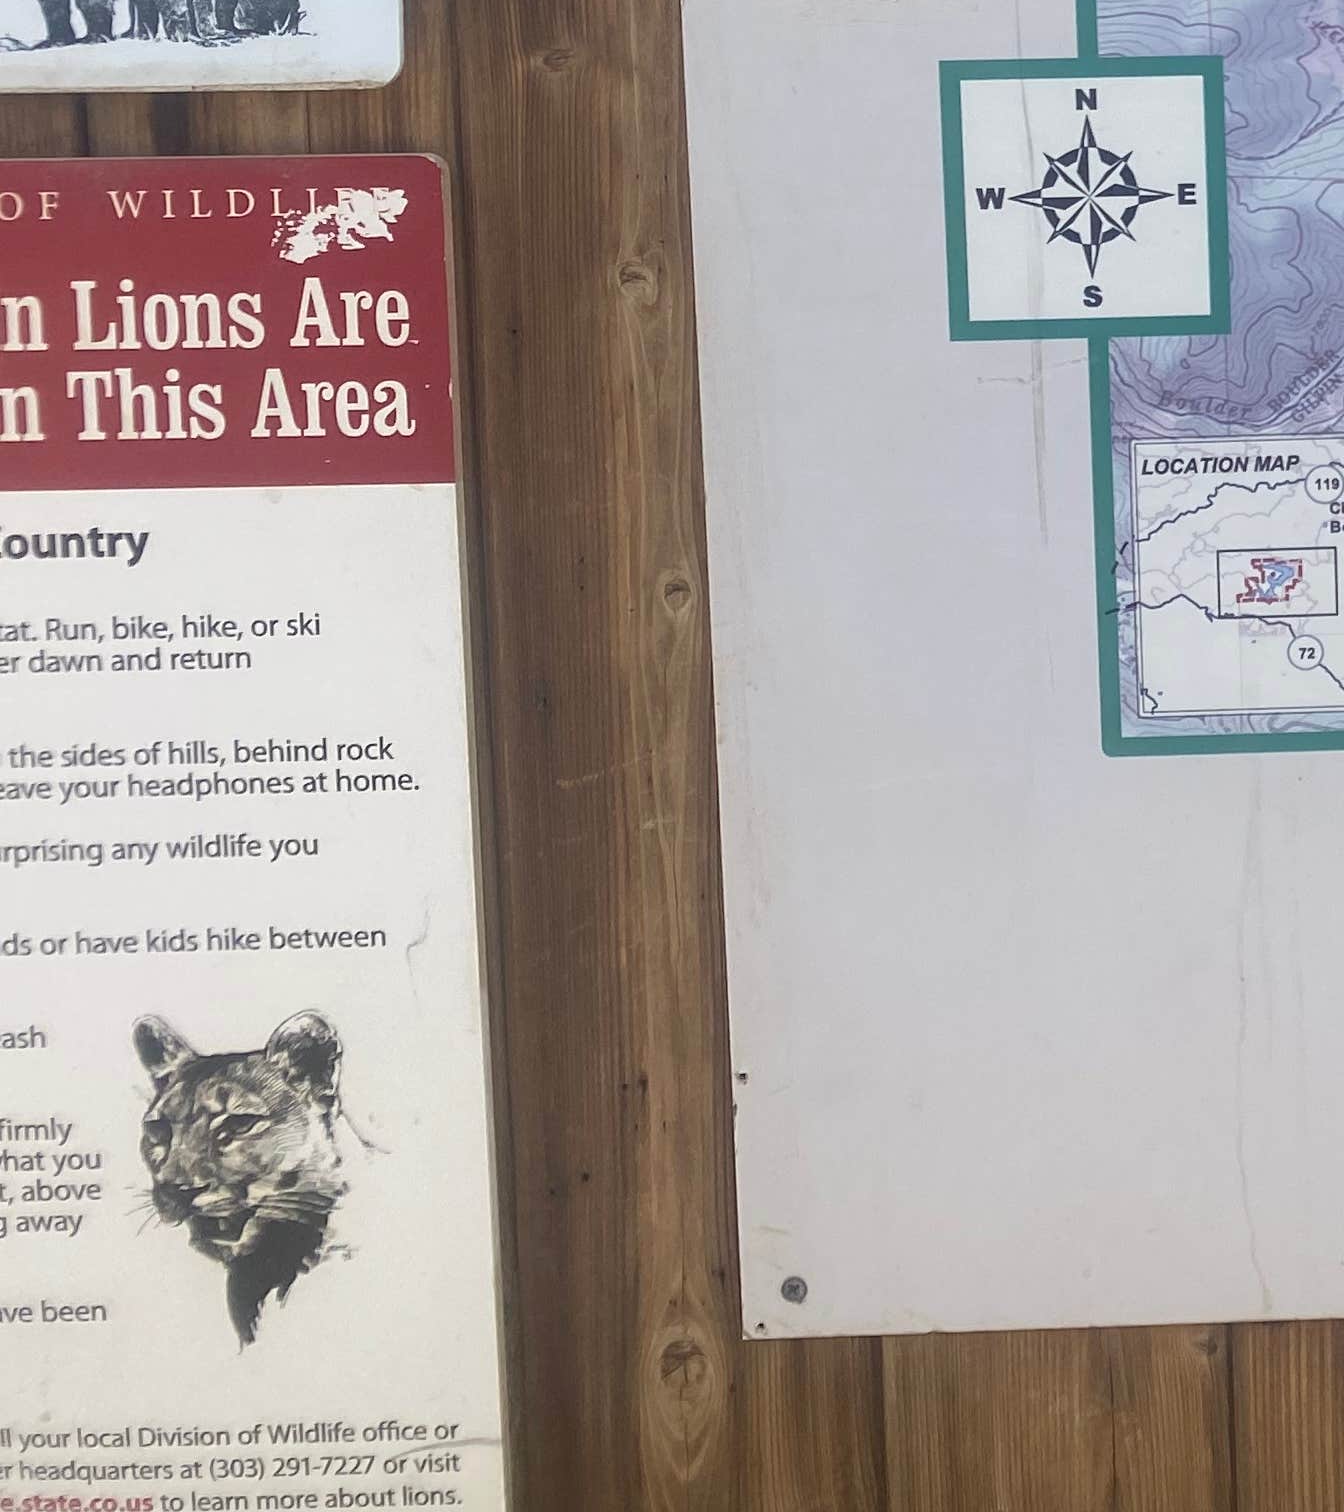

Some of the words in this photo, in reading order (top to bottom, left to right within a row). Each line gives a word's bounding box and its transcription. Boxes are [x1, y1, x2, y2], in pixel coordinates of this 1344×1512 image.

[0, 193, 60, 221] OF
[71, 279, 264, 350] Lions
[290, 278, 409, 346] Are
[67, 368, 225, 440] This
[251, 368, 415, 437] Area
[1142, 456, 1249, 475] LOCATION
[1254, 455, 1300, 472] MAP
[1315, 478, 1339, 490] 119
[1299, 647, 1315, 659] 72
[40, 938, 68, 955] or
[76, 931, 138, 954] have
[146, 929, 198, 952] kids
[207, 928, 261, 950] hike
[269, 927, 386, 949] between
[19, 1460, 173, 1485] headquarters
[180, 1462, 202, 1479] at
[210, 1457, 265, 1481] (303)
[273, 1455, 375, 1477] 291-7227
[384, 1456, 407, 1474] or
[414, 1453, 460, 1473] visit
